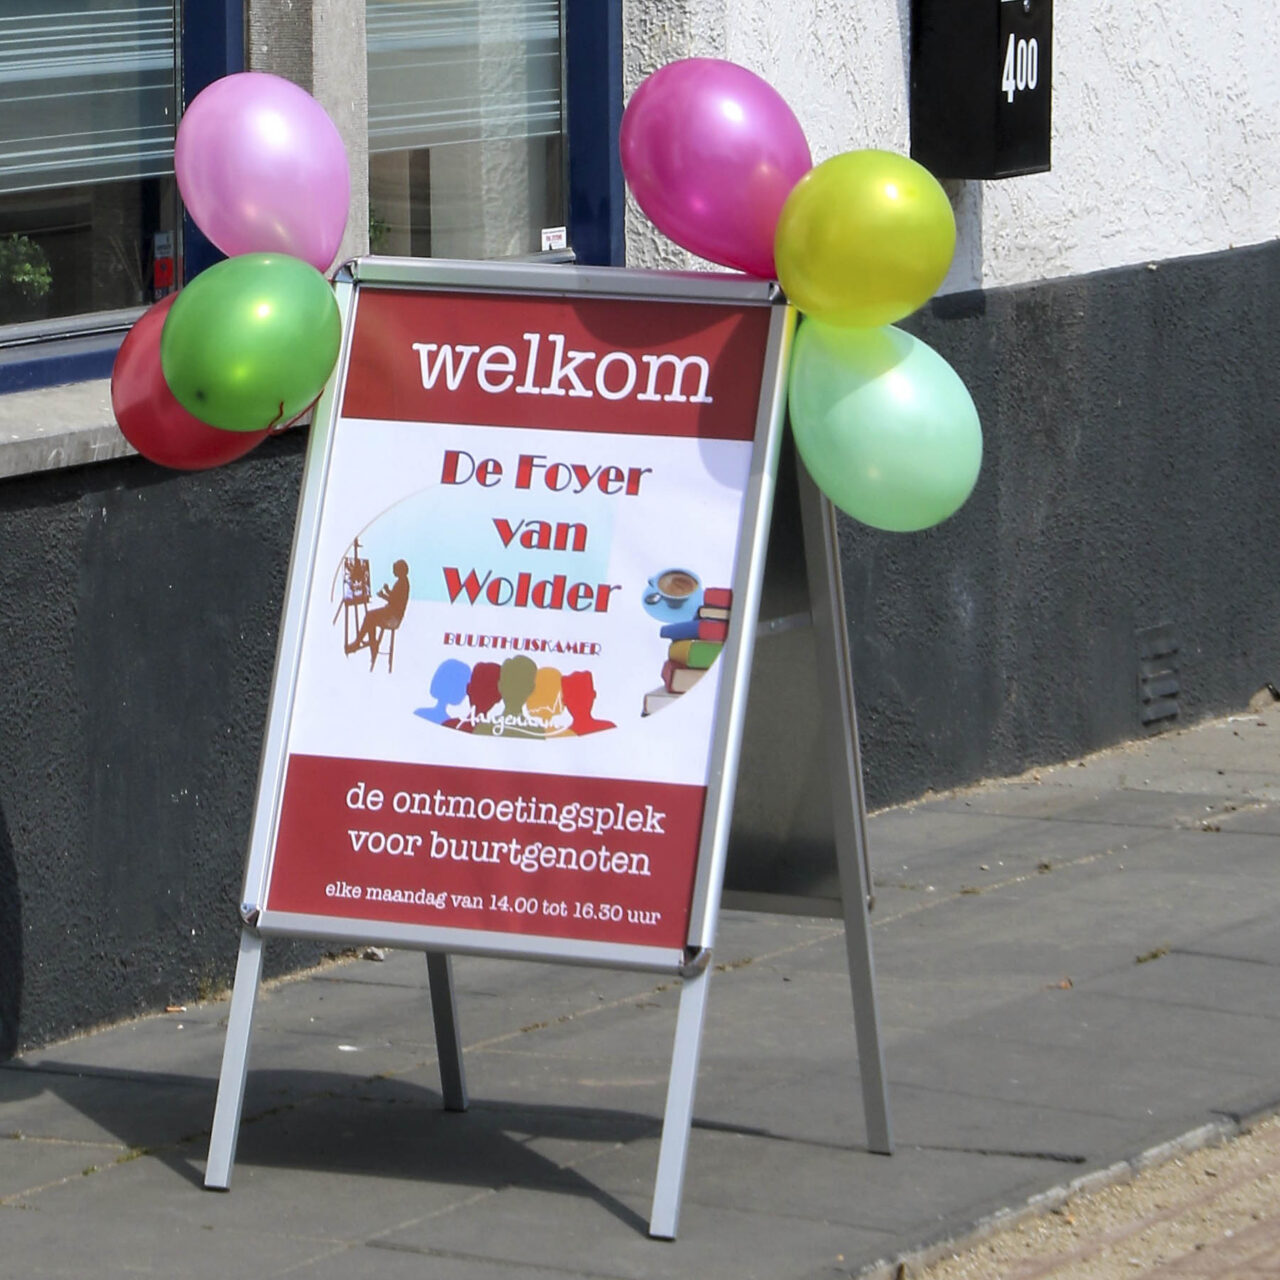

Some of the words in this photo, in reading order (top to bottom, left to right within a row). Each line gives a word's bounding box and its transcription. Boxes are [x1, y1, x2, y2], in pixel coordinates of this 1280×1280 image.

[1001, 33, 1038, 103] 400
[412, 333, 713, 404] welkom
[440, 450, 503, 487] De
[515, 454, 653, 496] Foyer
[492, 518, 588, 552] van
[442, 566, 622, 613] Wolder
[443, 631, 602, 656] BUURTHUISKAMER
[346, 782, 384, 810] de
[392, 789, 666, 835] ontmoetingsplek
[348, 829, 422, 856] voor
[430, 831, 651, 876] buurtgenoten
[325, 882, 362, 899] elke
[365, 885, 447, 909] maandag
[450, 893, 483, 910] van
[490, 894, 538, 915] 14.00
[542, 899, 568, 917] tot
[573, 902, 623, 921] 16.30
[627, 909, 661, 925] uur
